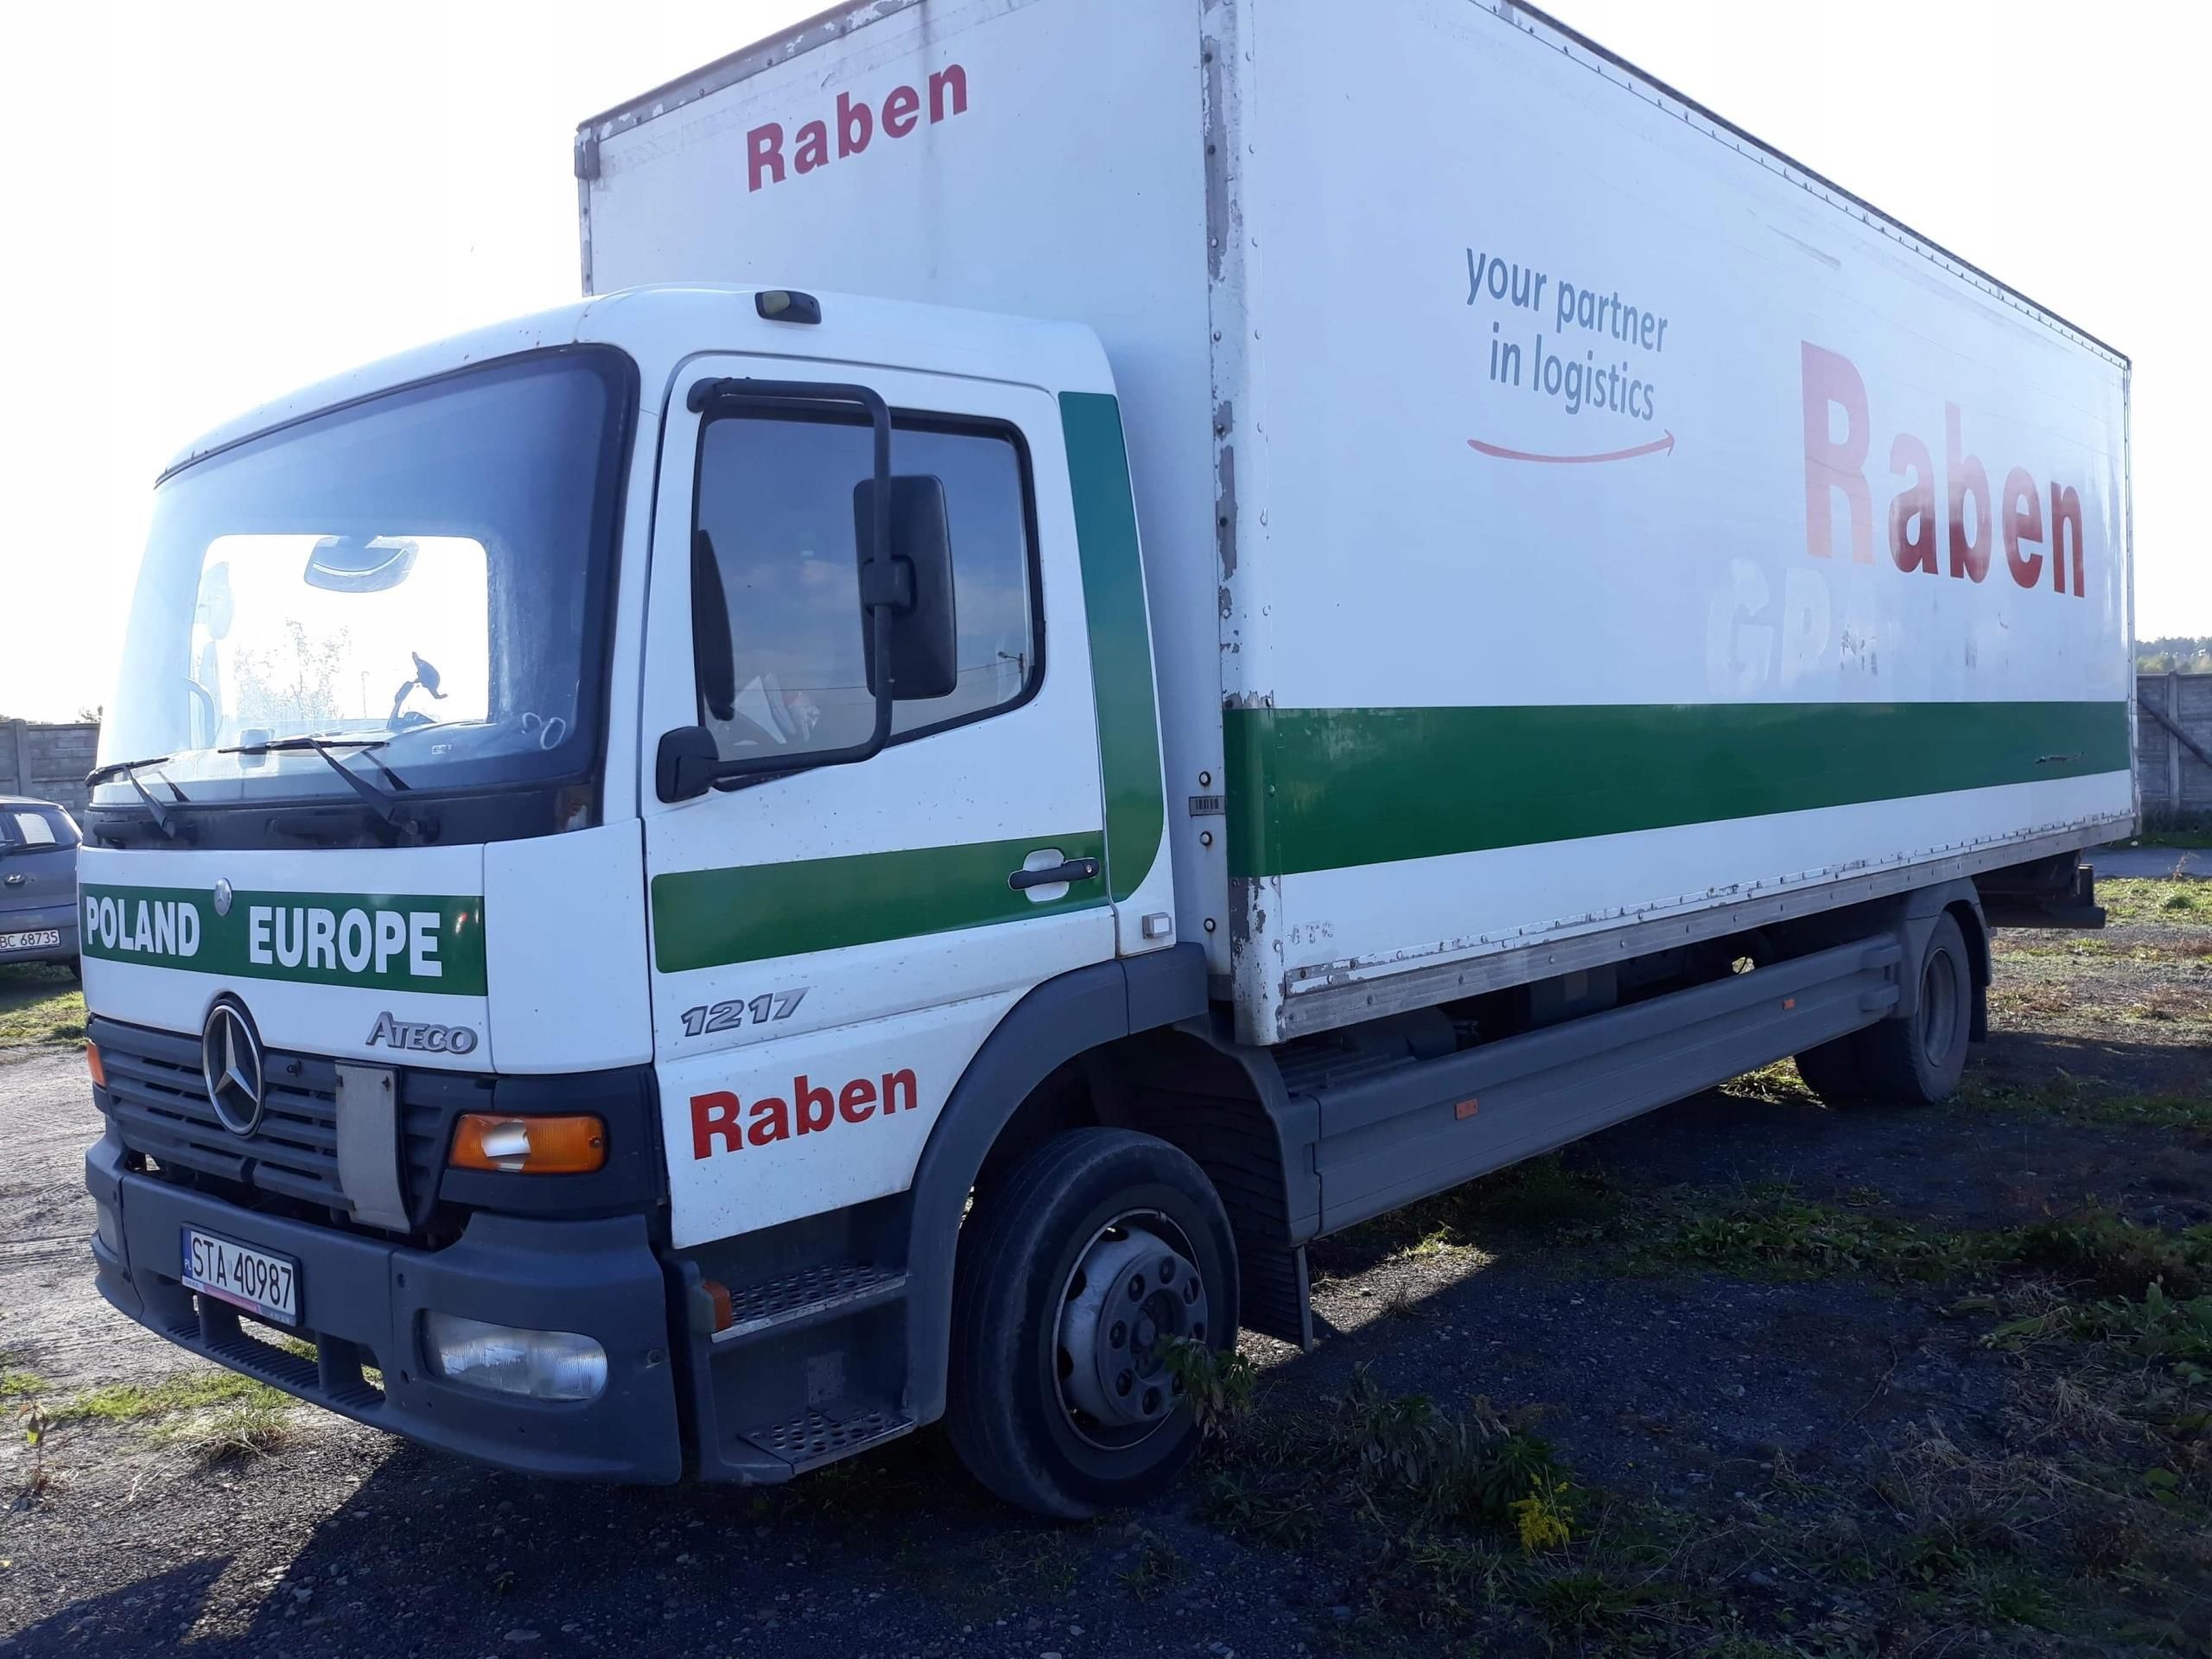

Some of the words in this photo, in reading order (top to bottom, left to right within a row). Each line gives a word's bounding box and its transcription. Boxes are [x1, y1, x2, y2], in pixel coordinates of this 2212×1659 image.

[747, 64, 967, 193] Raben
[1466, 247, 1548, 312] your
[1556, 280, 1668, 353] partner
[1490, 321, 1521, 386] in
[1533, 334, 1654, 421] logistics
[1801, 340, 2085, 598] Raben
[20, 931, 58, 946] 68735
[86, 896, 200, 957] POLAND
[249, 906, 442, 977] EUROPE
[680, 986, 810, 1037] 1217
[690, 1068, 918, 1160] Raben
